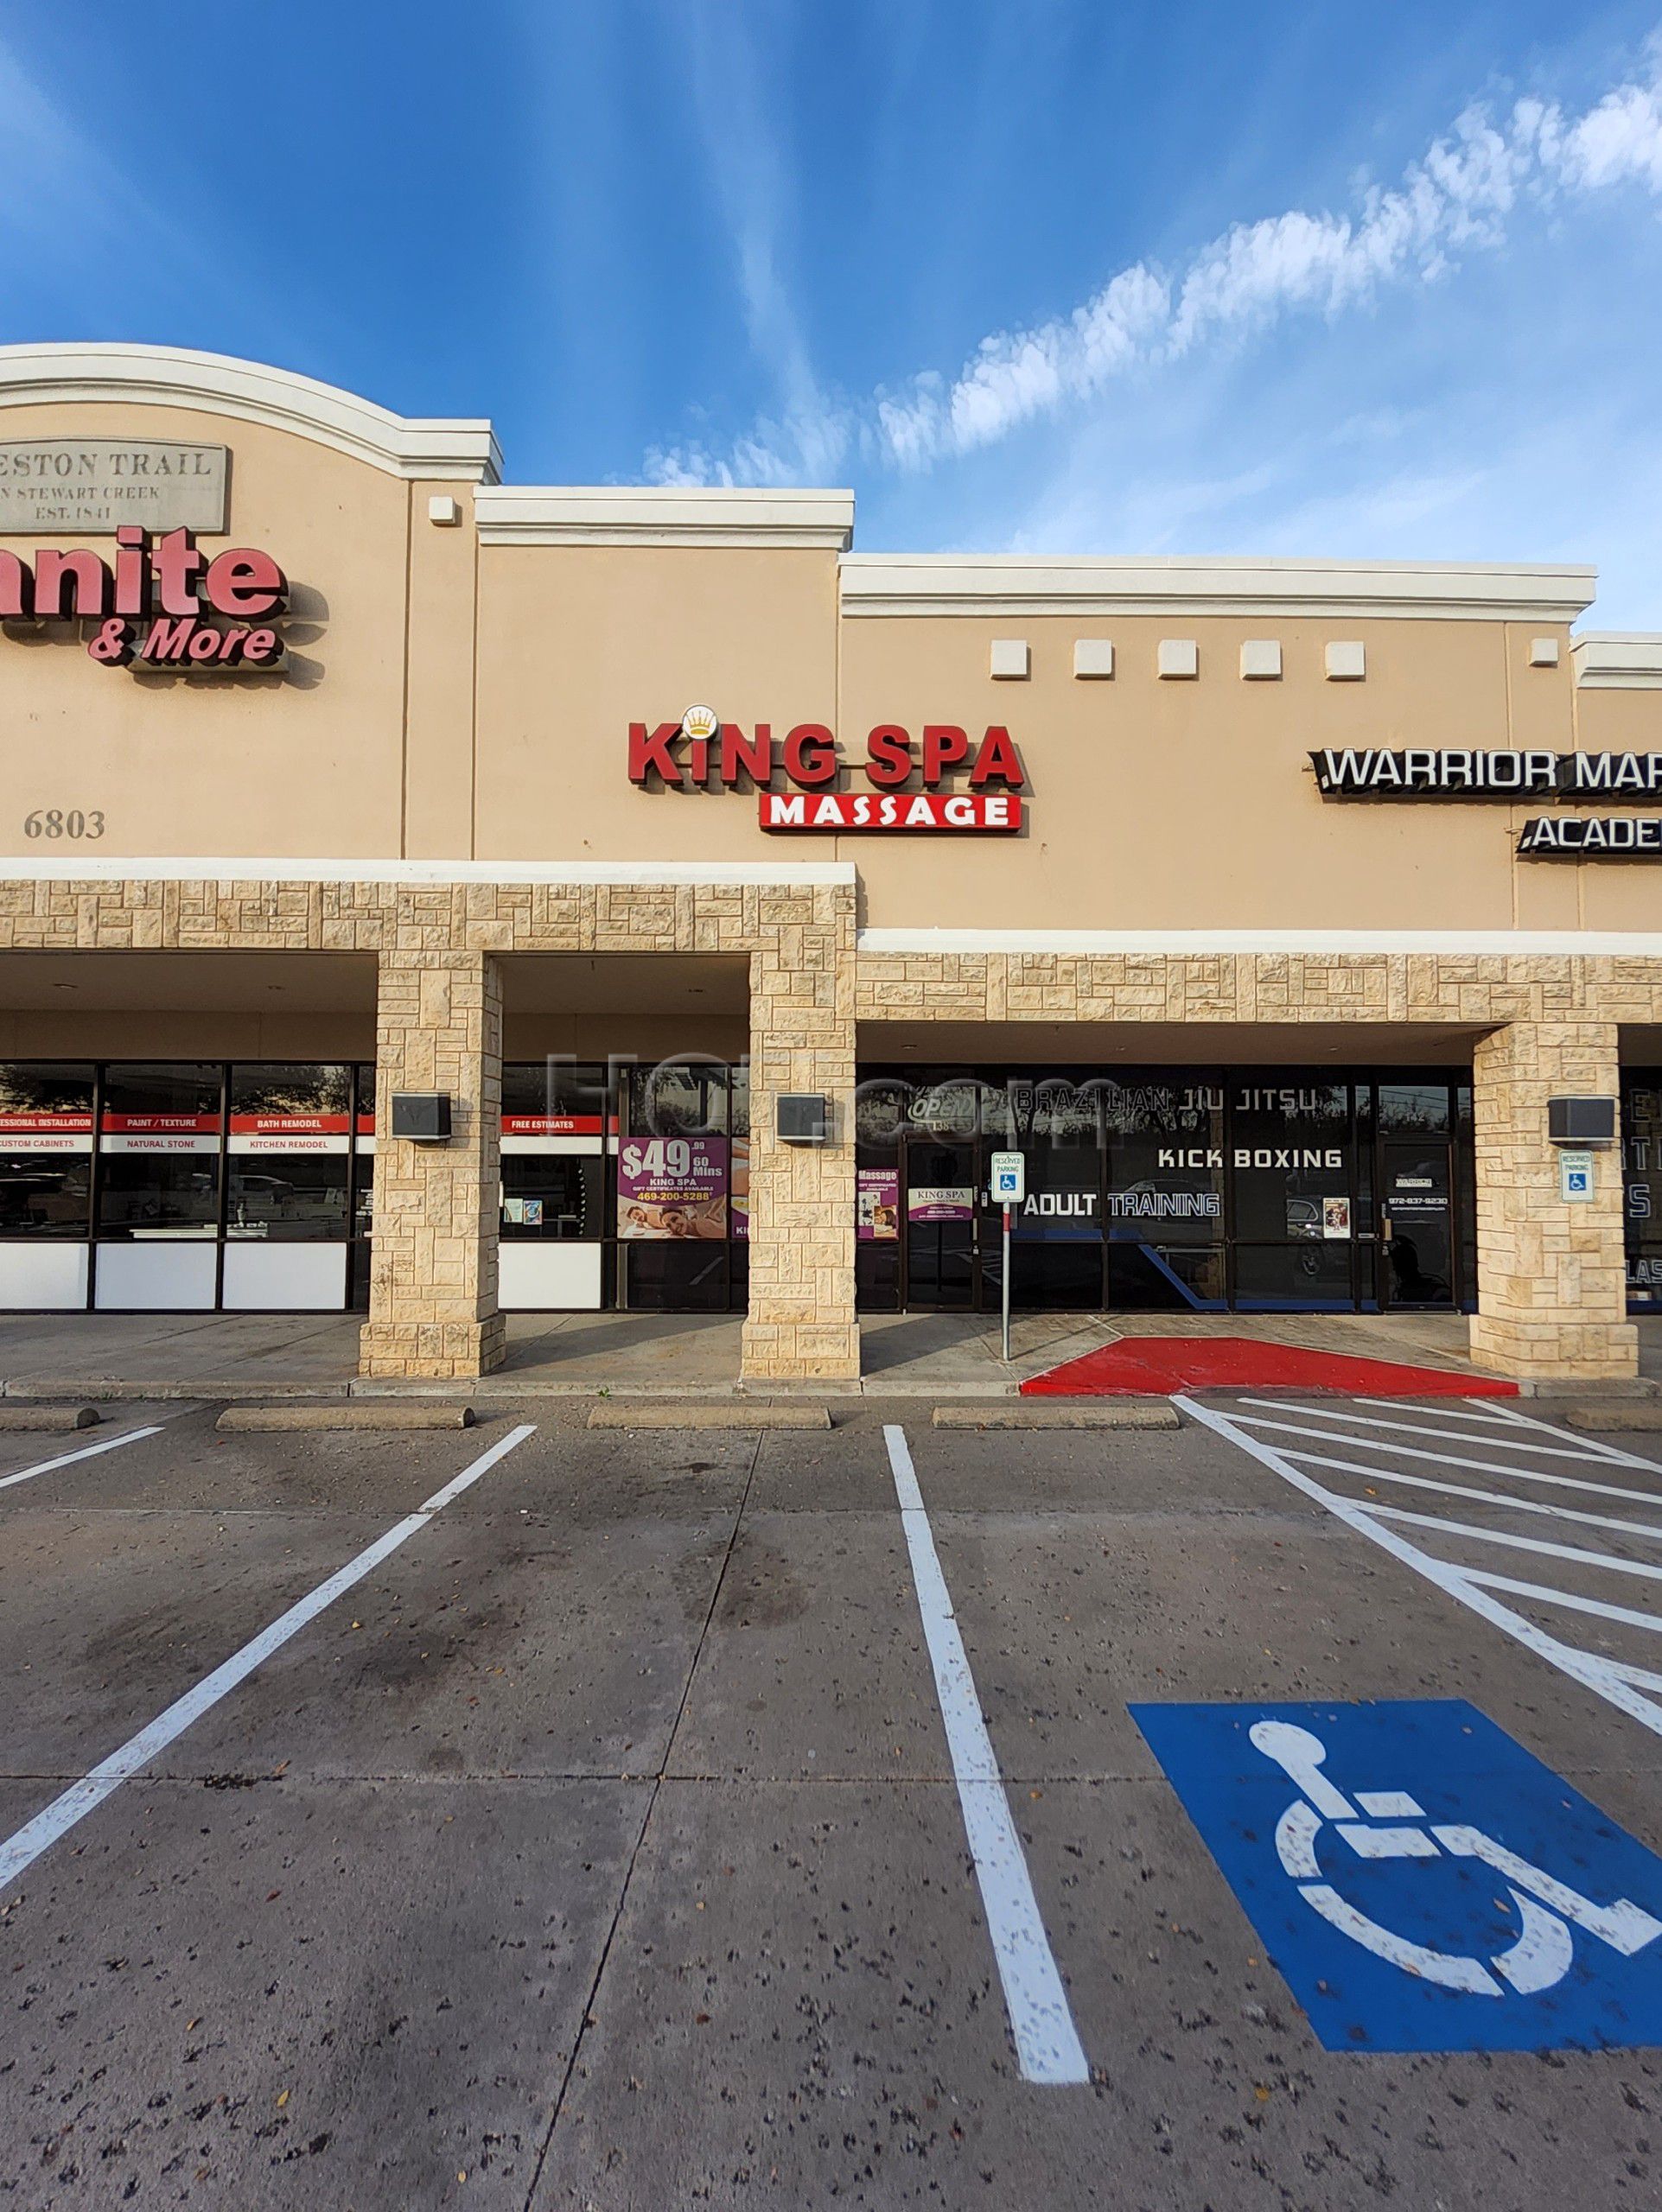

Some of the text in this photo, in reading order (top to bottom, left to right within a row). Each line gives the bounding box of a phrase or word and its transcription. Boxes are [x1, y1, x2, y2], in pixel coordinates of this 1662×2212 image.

[110, 453, 212, 475] TRAIL
[17, 486, 98, 499] STEWART
[103, 486, 160, 499] CREEK
[88, 618, 277, 660] & More
[865, 724, 1025, 787] SPA
[1324, 749, 1556, 786] WARRIOR
[770, 796, 1009, 826] MASSAGE
[24, 809, 105, 839] 6803
[1016, 1087, 1317, 1111] BRAZILIAN JIU JITSU
[38, 1118, 92, 1127] INSTALLATION
[127, 1118, 152, 1127] PAINT
[160, 1118, 197, 1127] TEXTURE
[257, 1119, 322, 1128] BATH REMODEL
[511, 1120, 575, 1129] FREE ESTIMATES
[126, 1140, 196, 1148] NATURAL STONE
[622, 1139, 691, 1180] $49
[692, 1156, 710, 1166] 60
[1158, 1149, 1342, 1168] KICK BOXING
[692, 1166, 723, 1177] Mins
[858, 1170, 897, 1181] Massage
[649, 1178, 697, 1186] KING SPA
[917, 1191, 965, 1199] KING SPA
[1023, 1193, 1220, 1217] ADULT TRAINING
